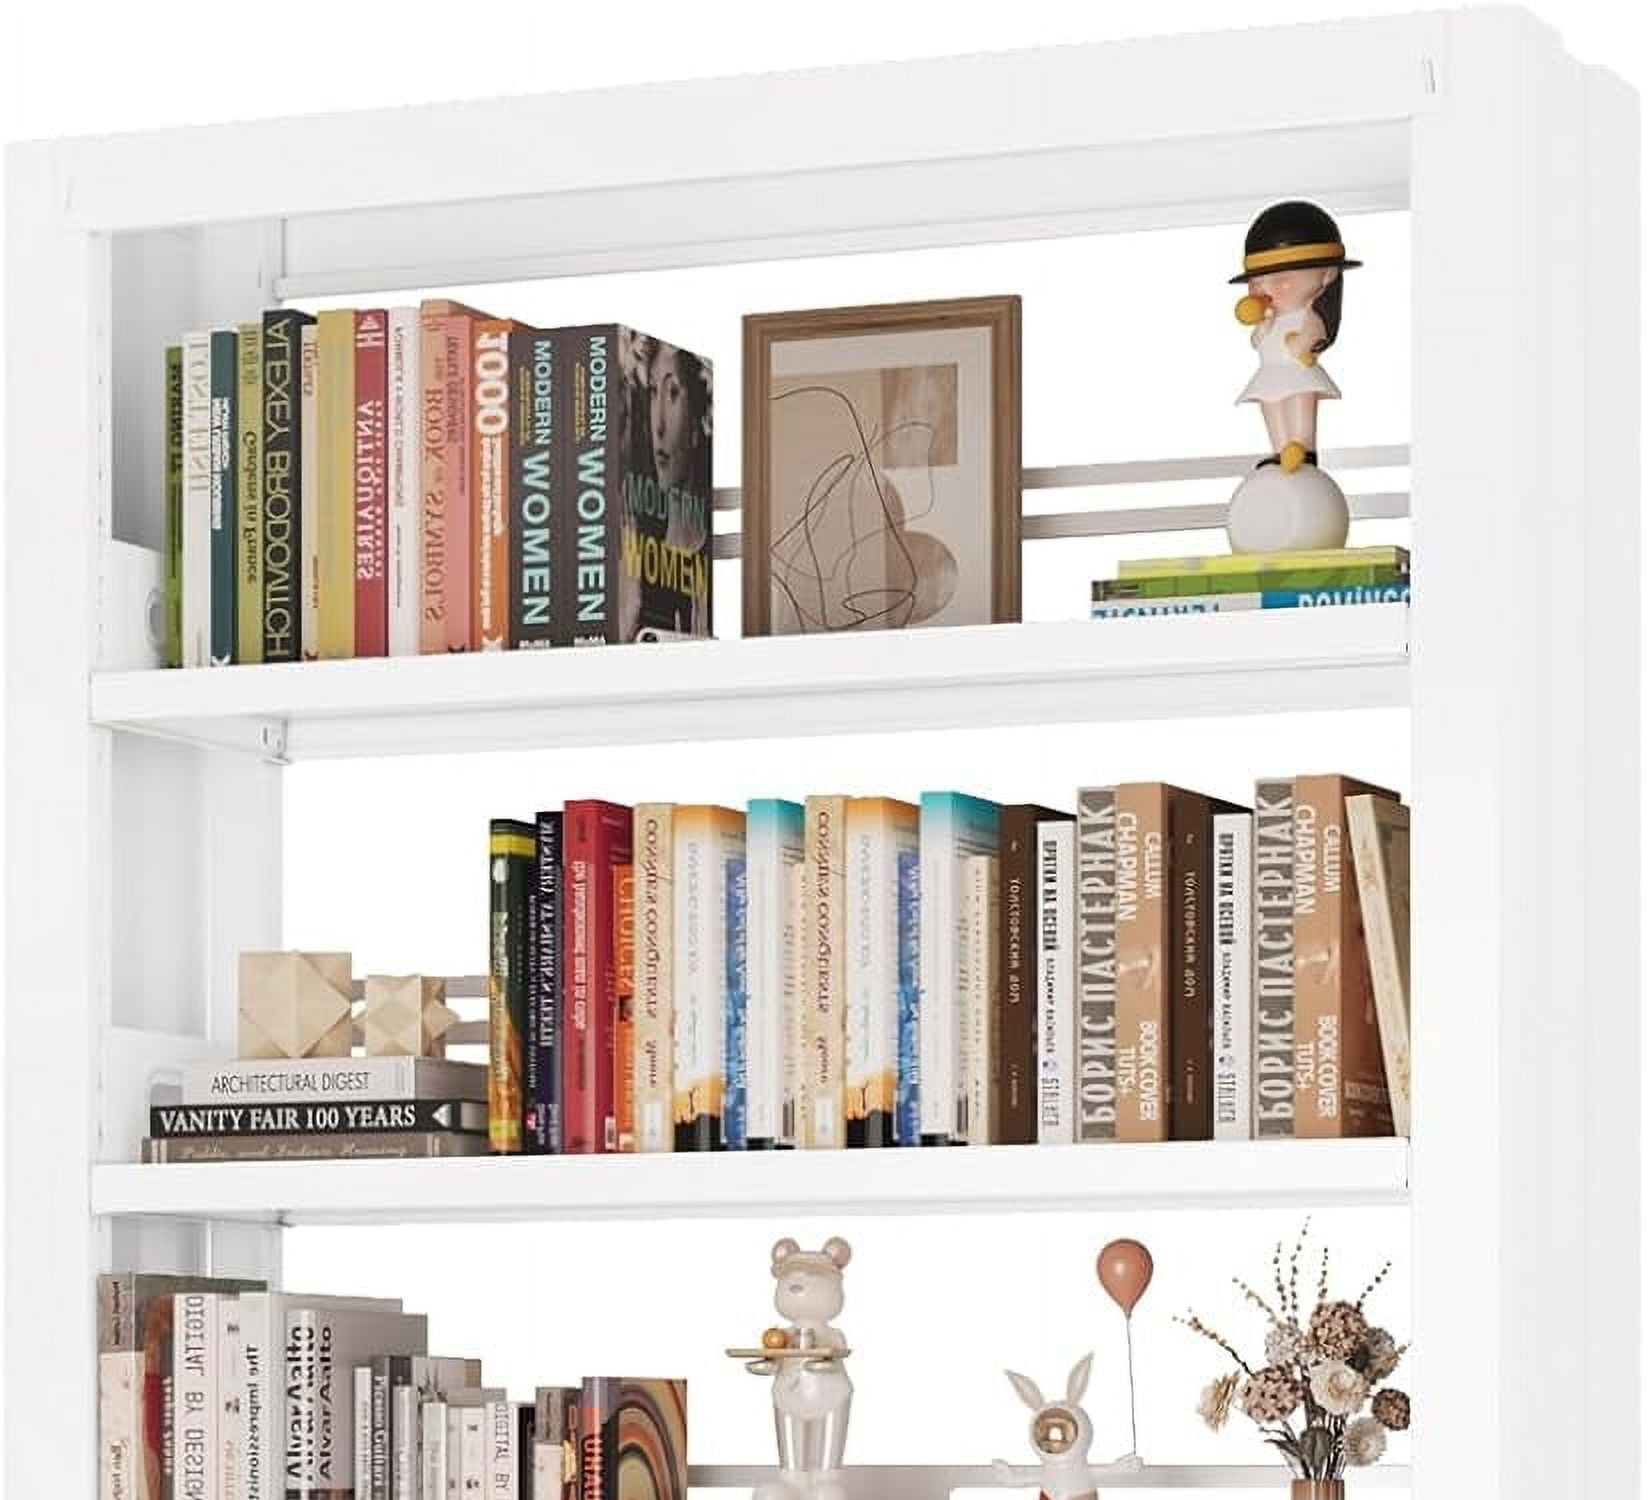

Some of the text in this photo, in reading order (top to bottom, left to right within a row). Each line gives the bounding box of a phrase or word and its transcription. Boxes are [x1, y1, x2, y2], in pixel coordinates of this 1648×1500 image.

[534, 340, 551, 445] MODERN
[589, 336, 607, 441] MODERN
[522, 451, 550, 625] WOMEN
[577, 448, 606, 621] WOMEN
[621, 524, 708, 602] WOMEN
[1118, 812, 1137, 923] CHAPMAN
[1144, 831, 1162, 899] CALLUM
[1296, 805, 1316, 915] CHAPMAN
[1323, 823, 1340, 894] CALLUM
[1080, 803, 1115, 1124] БОРИС ПАСТЕРНАК
[1258, 796, 1294, 1119] БОРИС ПАСТЕРНАК
[159, 1103, 417, 1133] VANITY FAIR 100 YEARS
[211, 1071, 372, 1096] ARCHITECTURAL DIGEST
[319, 1326, 332, 1480] Alvar Aalto
[495, 1473, 510, 1490] BY
